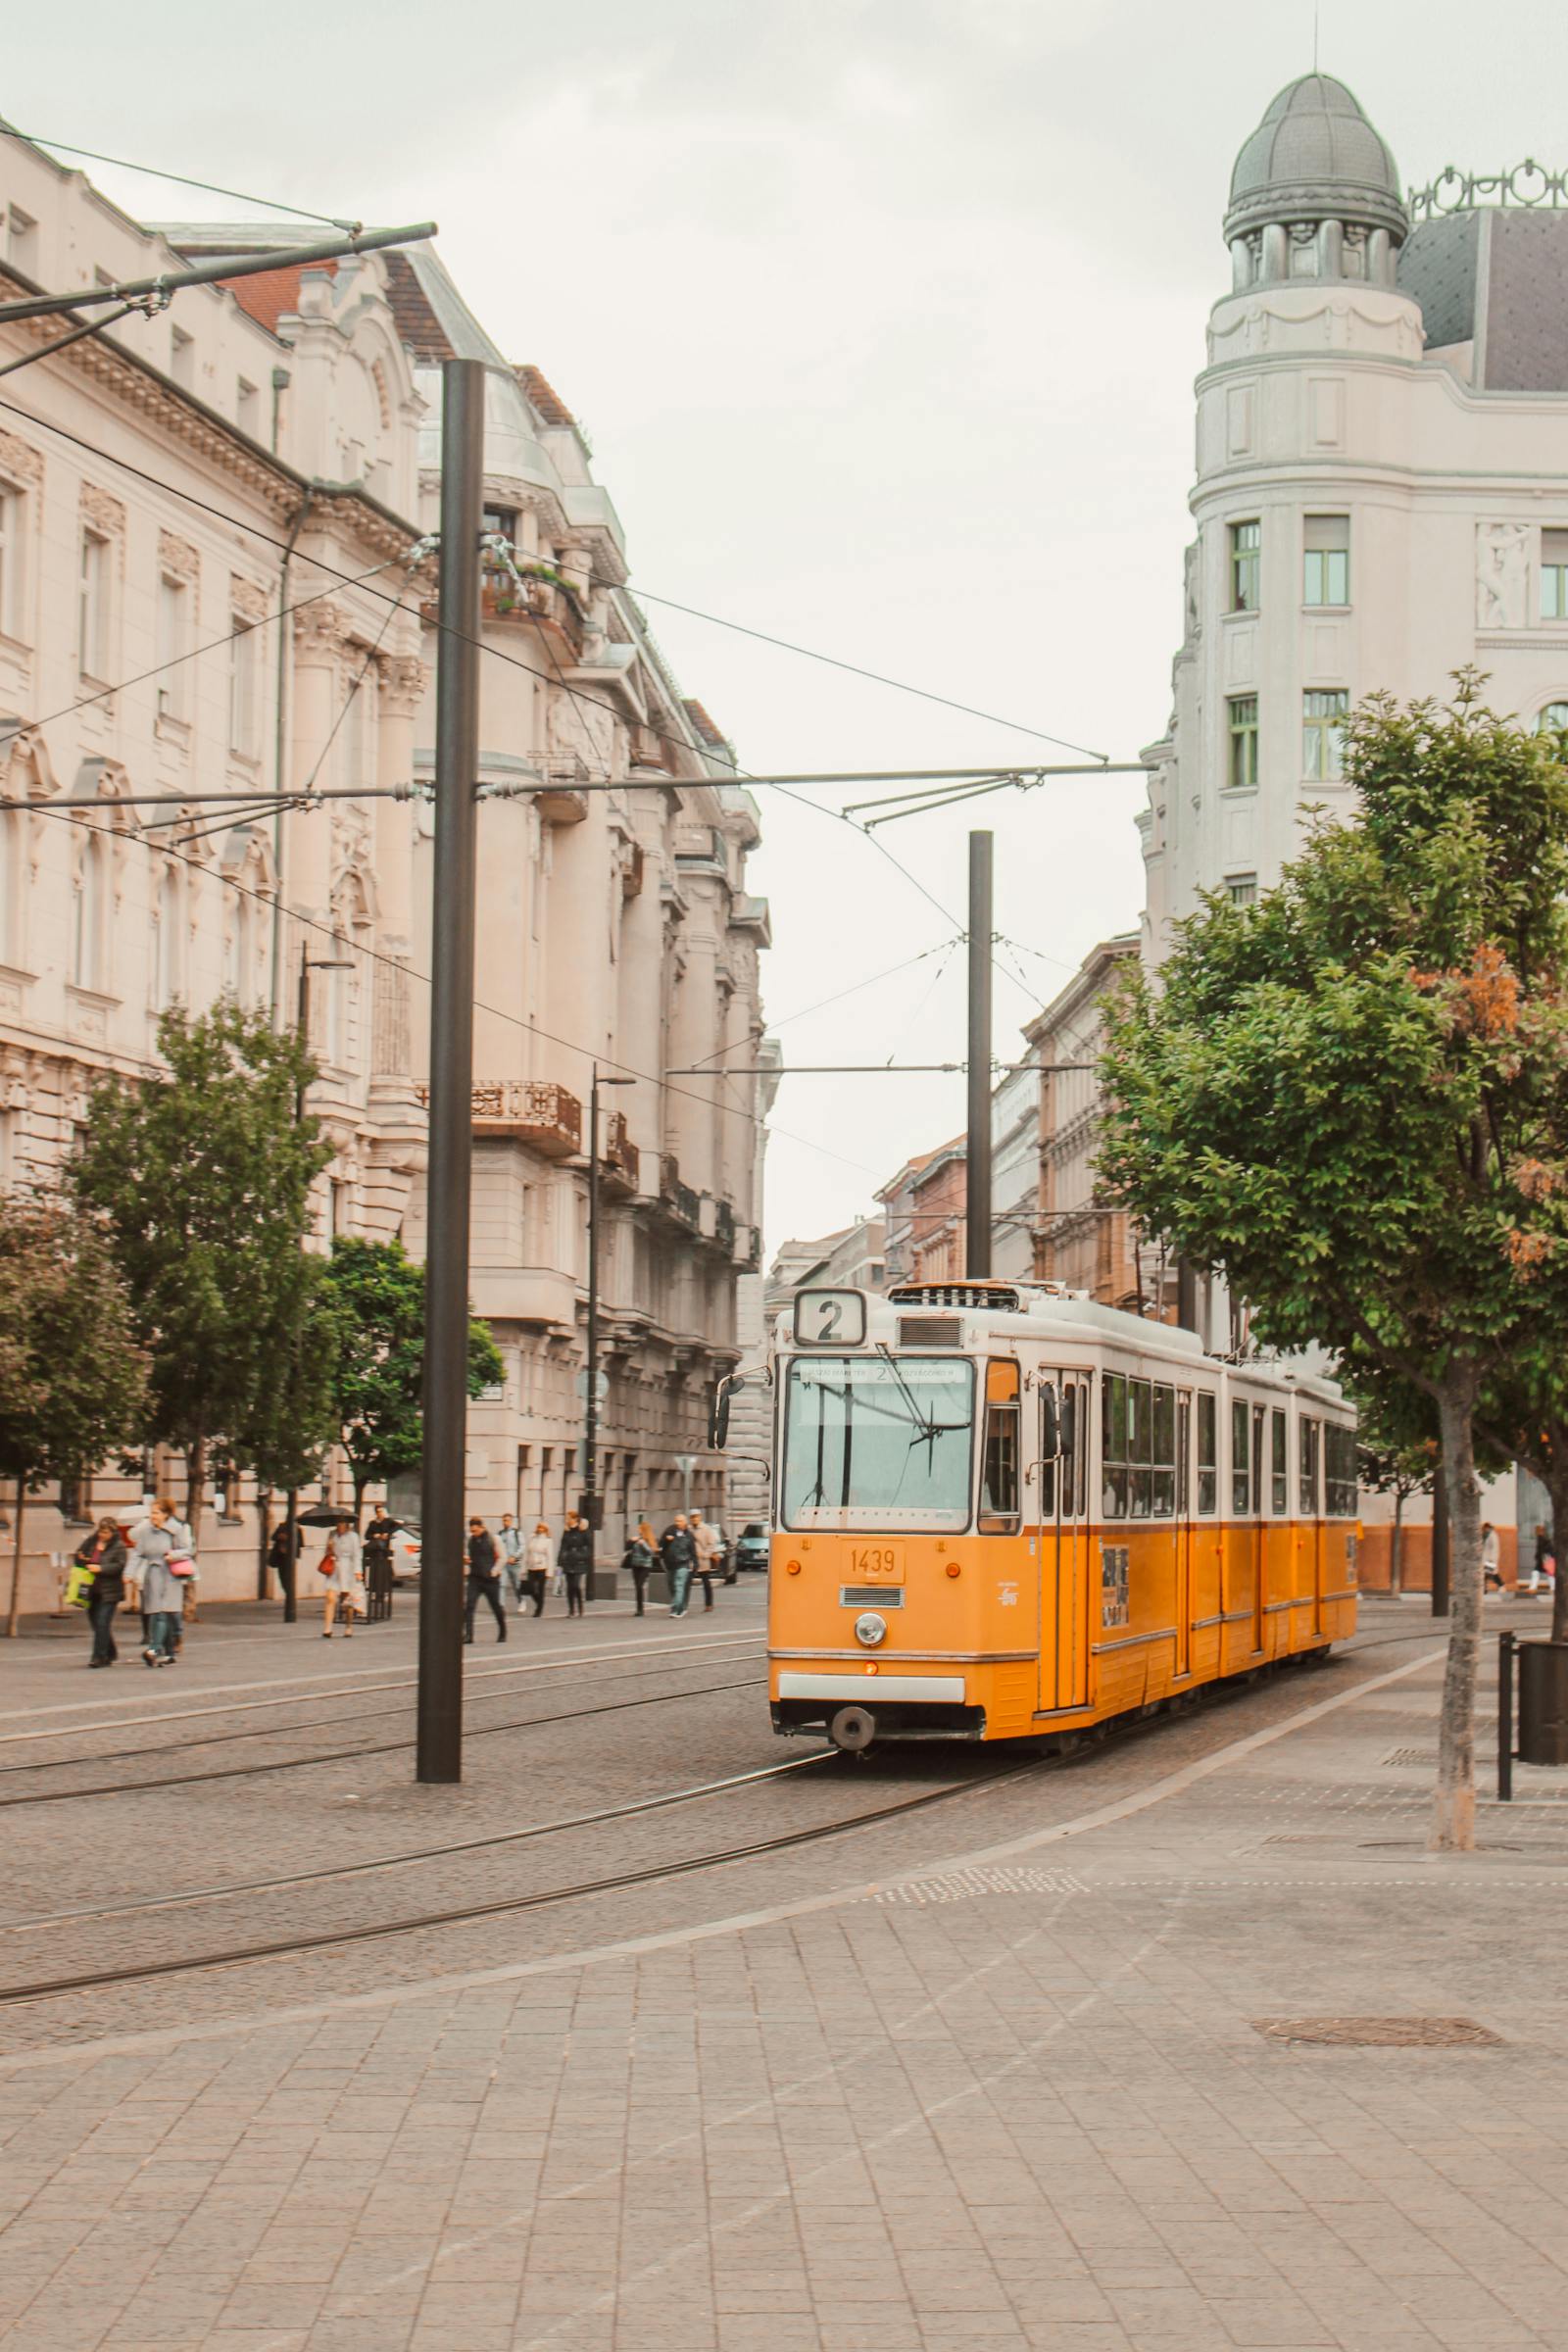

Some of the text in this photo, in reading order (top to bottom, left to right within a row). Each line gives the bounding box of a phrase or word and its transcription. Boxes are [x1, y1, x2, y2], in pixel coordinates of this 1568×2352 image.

[817, 1300, 842, 1341] 2
[877, 1367, 887, 1381] 2
[851, 1548, 895, 1572] 1439
